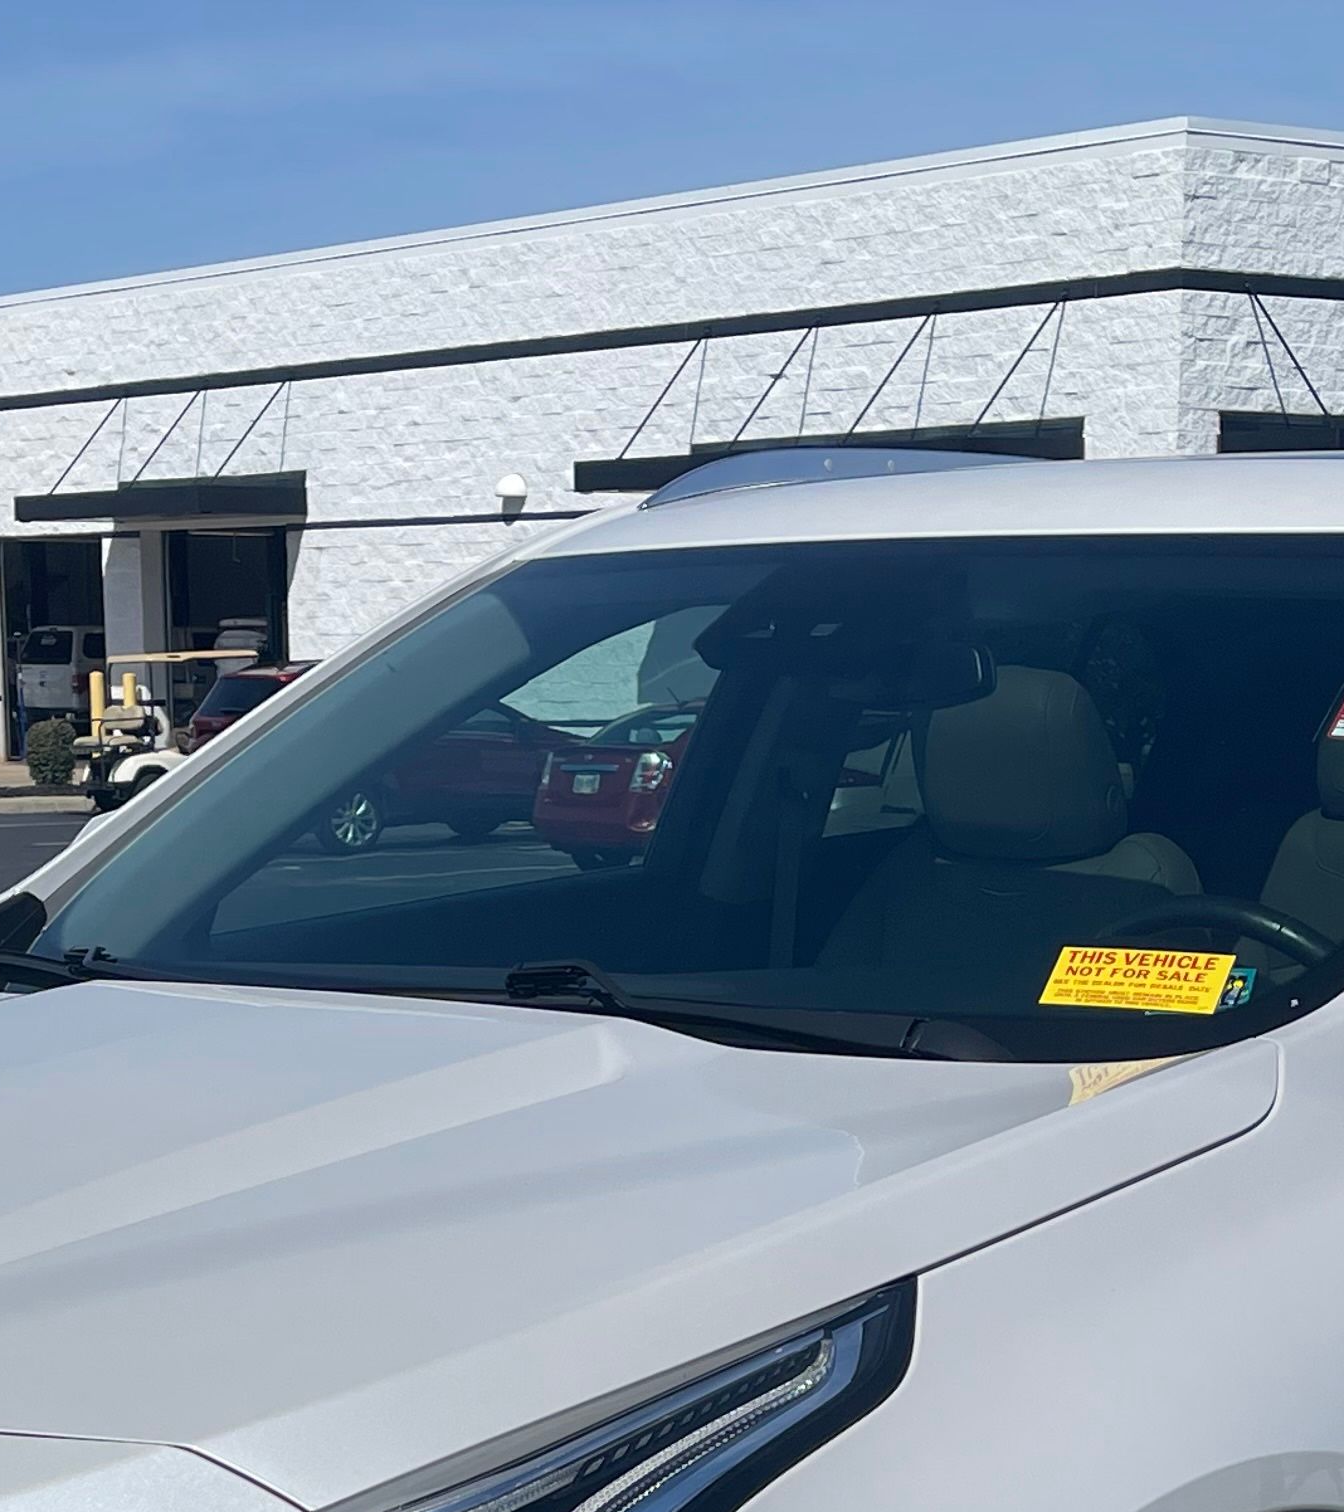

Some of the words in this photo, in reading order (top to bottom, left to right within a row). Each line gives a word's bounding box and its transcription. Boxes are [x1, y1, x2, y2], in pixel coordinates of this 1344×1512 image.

[1069, 950, 1117, 965] THIS
[1125, 952, 1219, 971] VEHICLE
[1065, 966, 1105, 978] NOT
[1110, 967, 1150, 980] FOR
[1157, 971, 1208, 984] SALE
